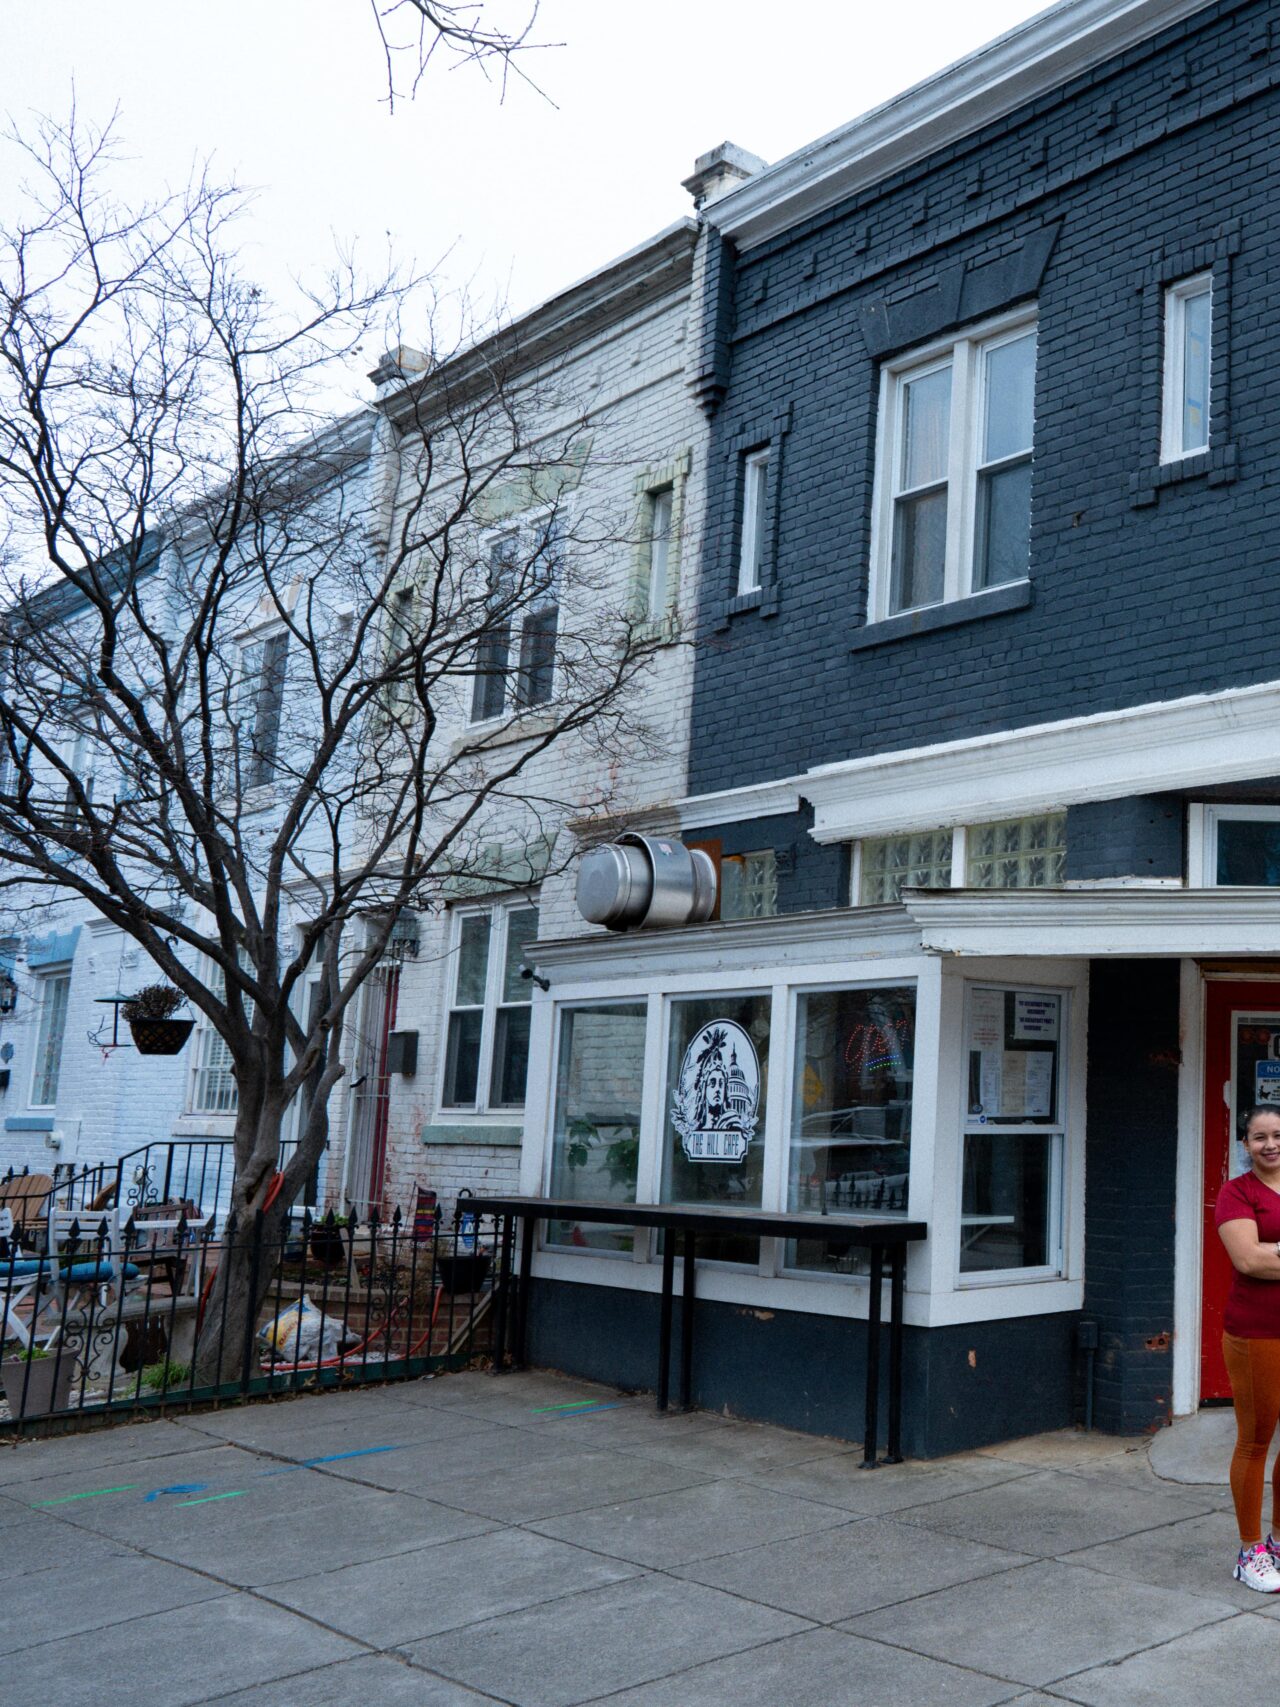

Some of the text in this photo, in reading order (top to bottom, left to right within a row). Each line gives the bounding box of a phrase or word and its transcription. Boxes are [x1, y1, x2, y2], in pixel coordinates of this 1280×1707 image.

[692, 1133, 739, 1156] THE HILL CAFE
